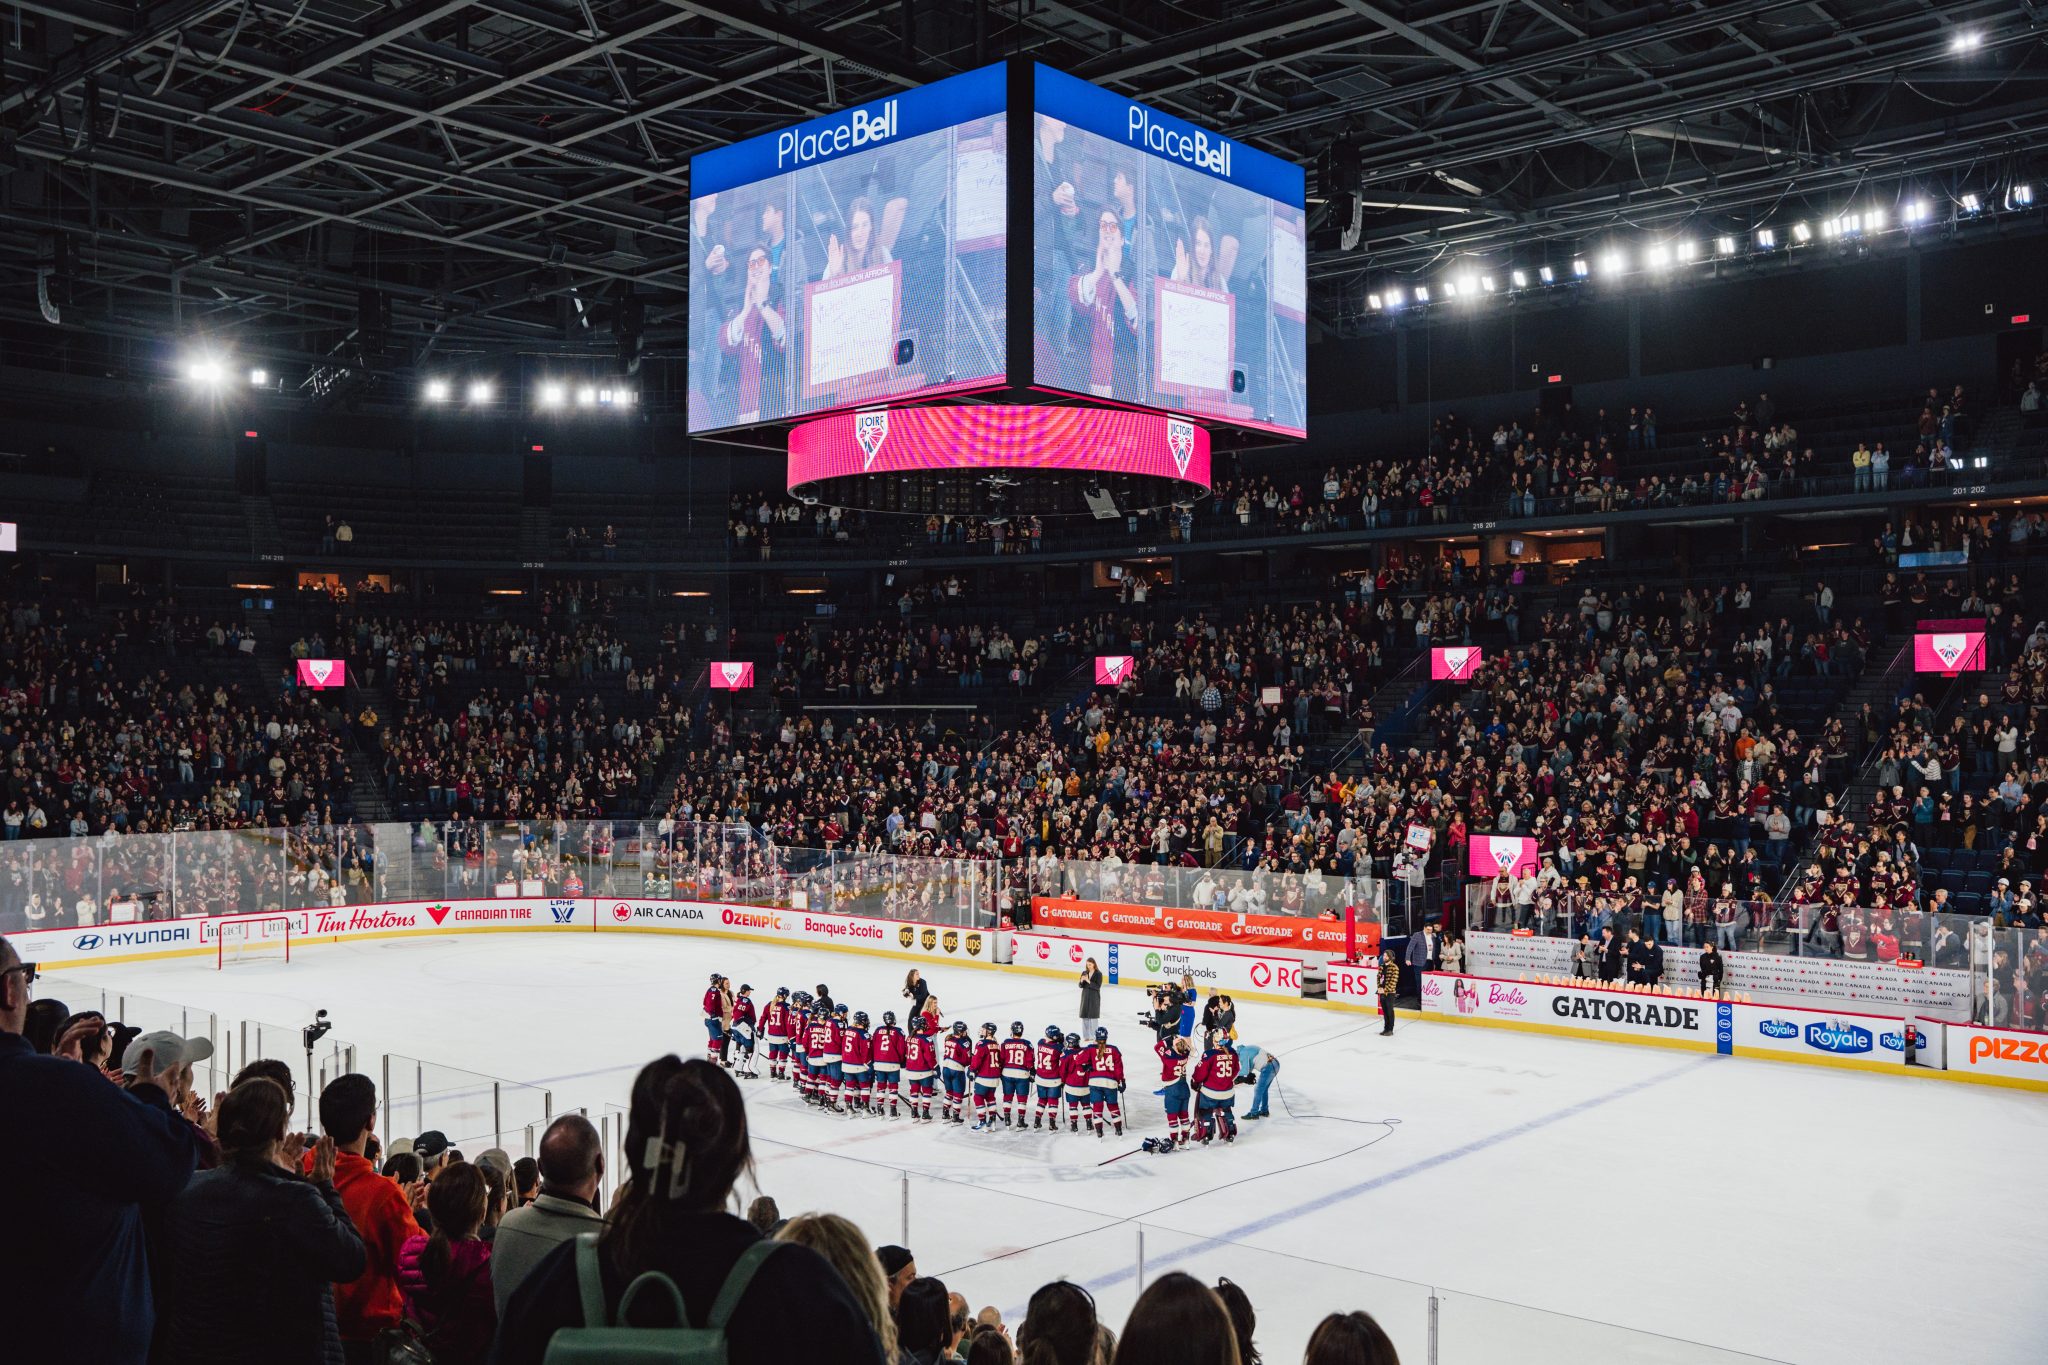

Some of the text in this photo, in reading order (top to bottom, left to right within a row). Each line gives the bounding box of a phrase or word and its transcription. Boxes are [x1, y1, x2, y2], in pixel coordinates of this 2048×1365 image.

[315, 908, 416, 933] Tim Hortons
[455, 908, 532, 921] CANADIAN TIRE
[634, 907, 704, 919] AIR CANADA
[1051, 908, 1093, 920] GATORADE
[1112, 913, 1155, 926] GATORADE
[804, 918, 884, 939] Banque Scotia
[1177, 920, 1222, 932] GATORADE
[1245, 925, 1293, 938] GATORADE
[109, 928, 190, 946] HYUNDAI
[899, 931, 914, 946] ups
[921, 933, 936, 948] ups
[943, 935, 958, 950] ups
[966, 937, 981, 953] ups
[1317, 930, 1369, 944] GATORDE
[1163, 954, 1190, 964] INTUIT
[1163, 965, 1217, 979] quickbooks
[1421, 979, 1443, 997] rbie
[1488, 983, 1527, 1005] Barbie
[769, 1011, 781, 1026] 51
[1552, 995, 1699, 1031] GATORADE
[1762, 1022, 1796, 1038] Royale
[845, 1037, 853, 1053] 5
[880, 1035, 889, 1051] 2
[1809, 1029, 1868, 1050] Royale
[1008, 1049, 1025, 1066] 18
[1038, 1052, 1052, 1070] 14
[1095, 1054, 1115, 1071] 24
[1216, 1060, 1233, 1078] 35
